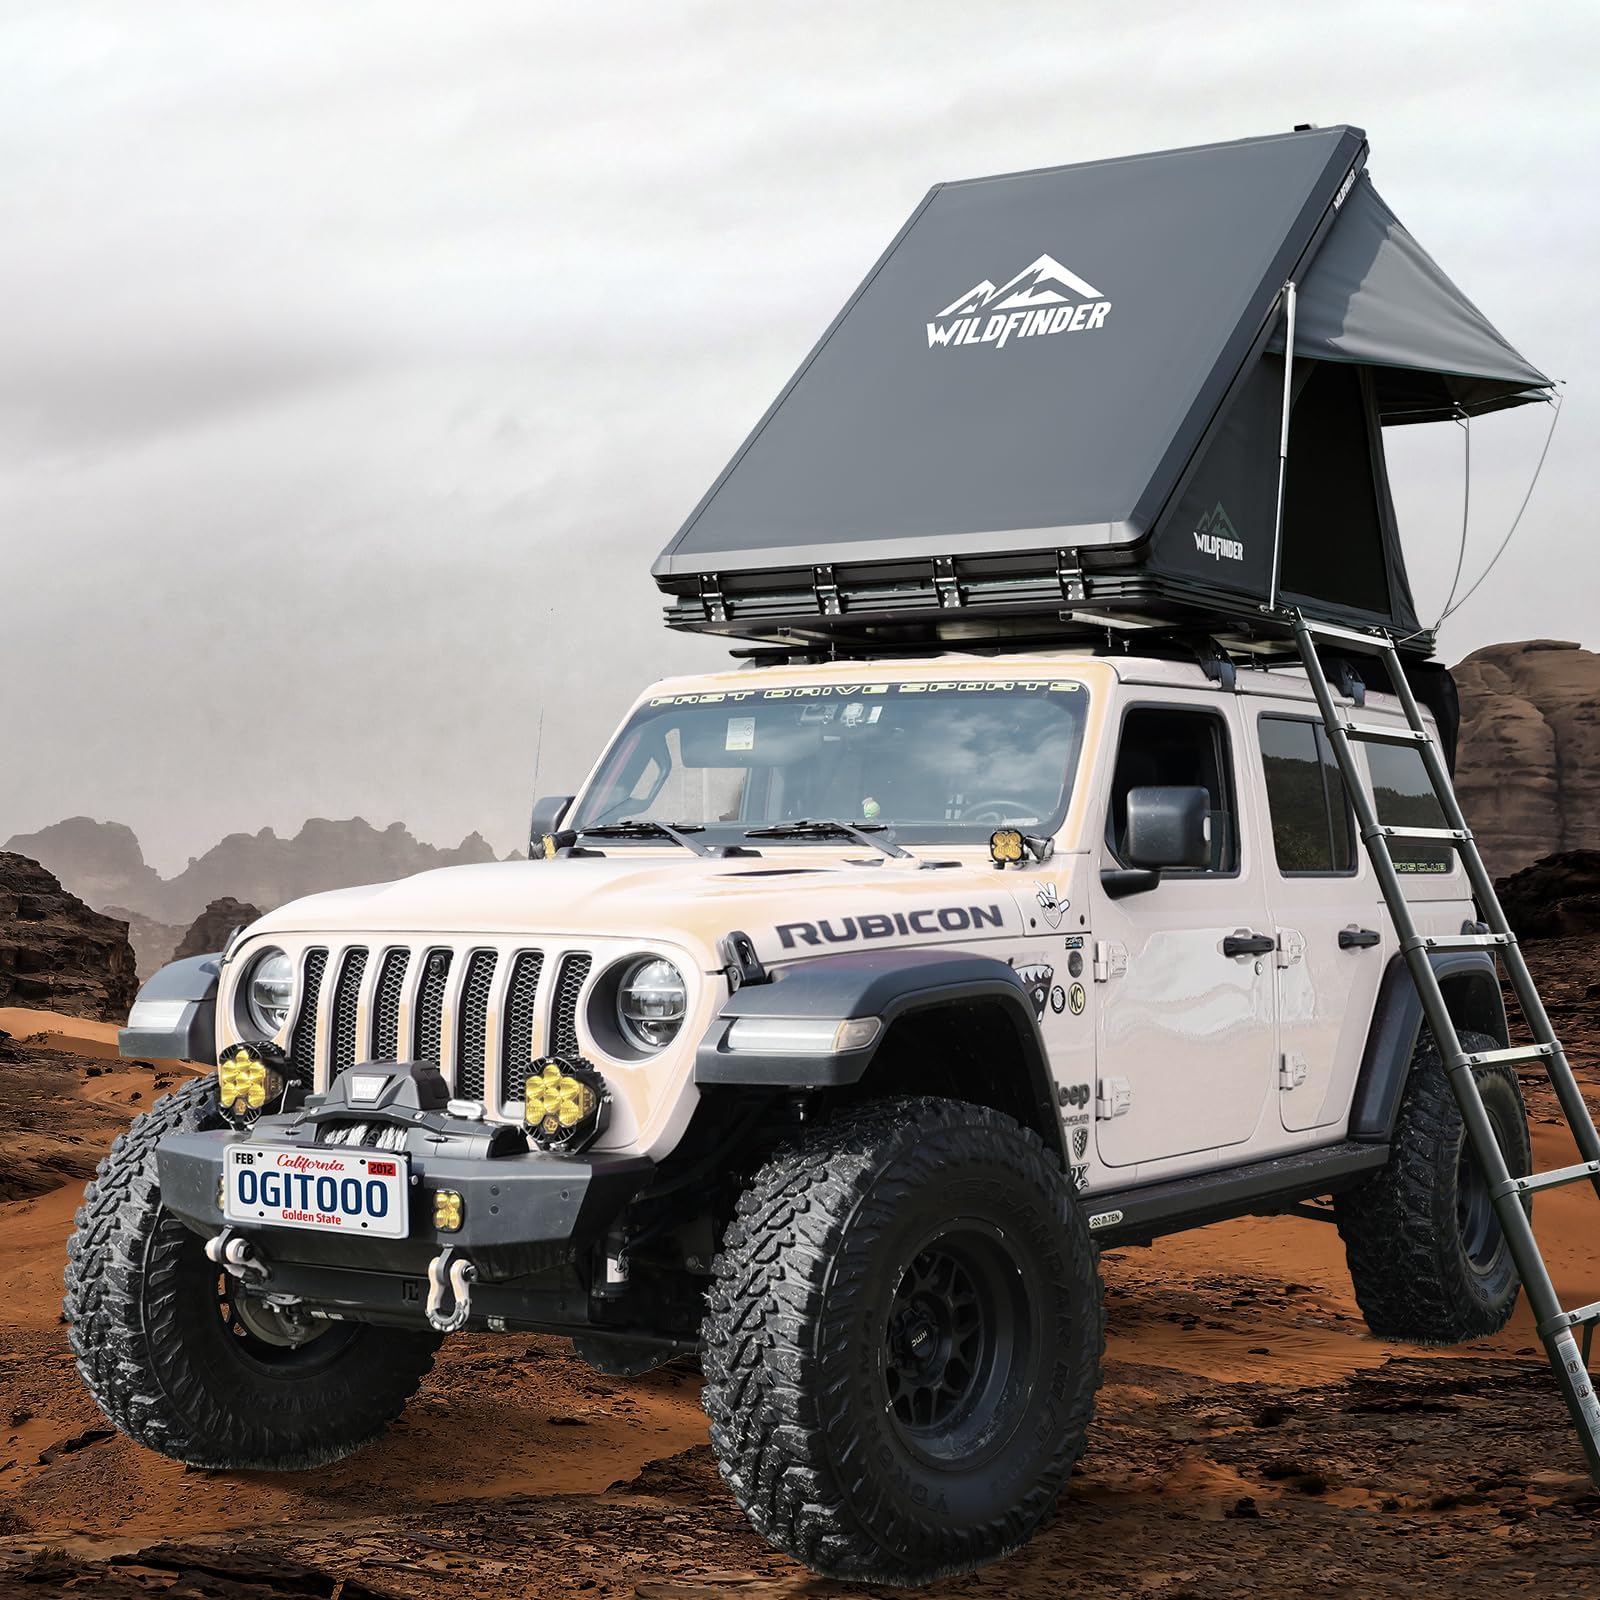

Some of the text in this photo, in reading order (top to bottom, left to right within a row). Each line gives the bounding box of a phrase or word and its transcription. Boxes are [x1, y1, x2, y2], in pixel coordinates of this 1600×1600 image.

[926, 301, 1112, 349] WILDFINDER
[1193, 531, 1244, 561] WILDFINDER
[650, 681, 1081, 706] FAST DRIVE SPORTS
[775, 904, 1004, 949] RUBICON
[1071, 986, 1083, 1011] KC
[235, 1152, 393, 1175] FEB California 2012
[282, 1209, 342, 1225] Golden State
